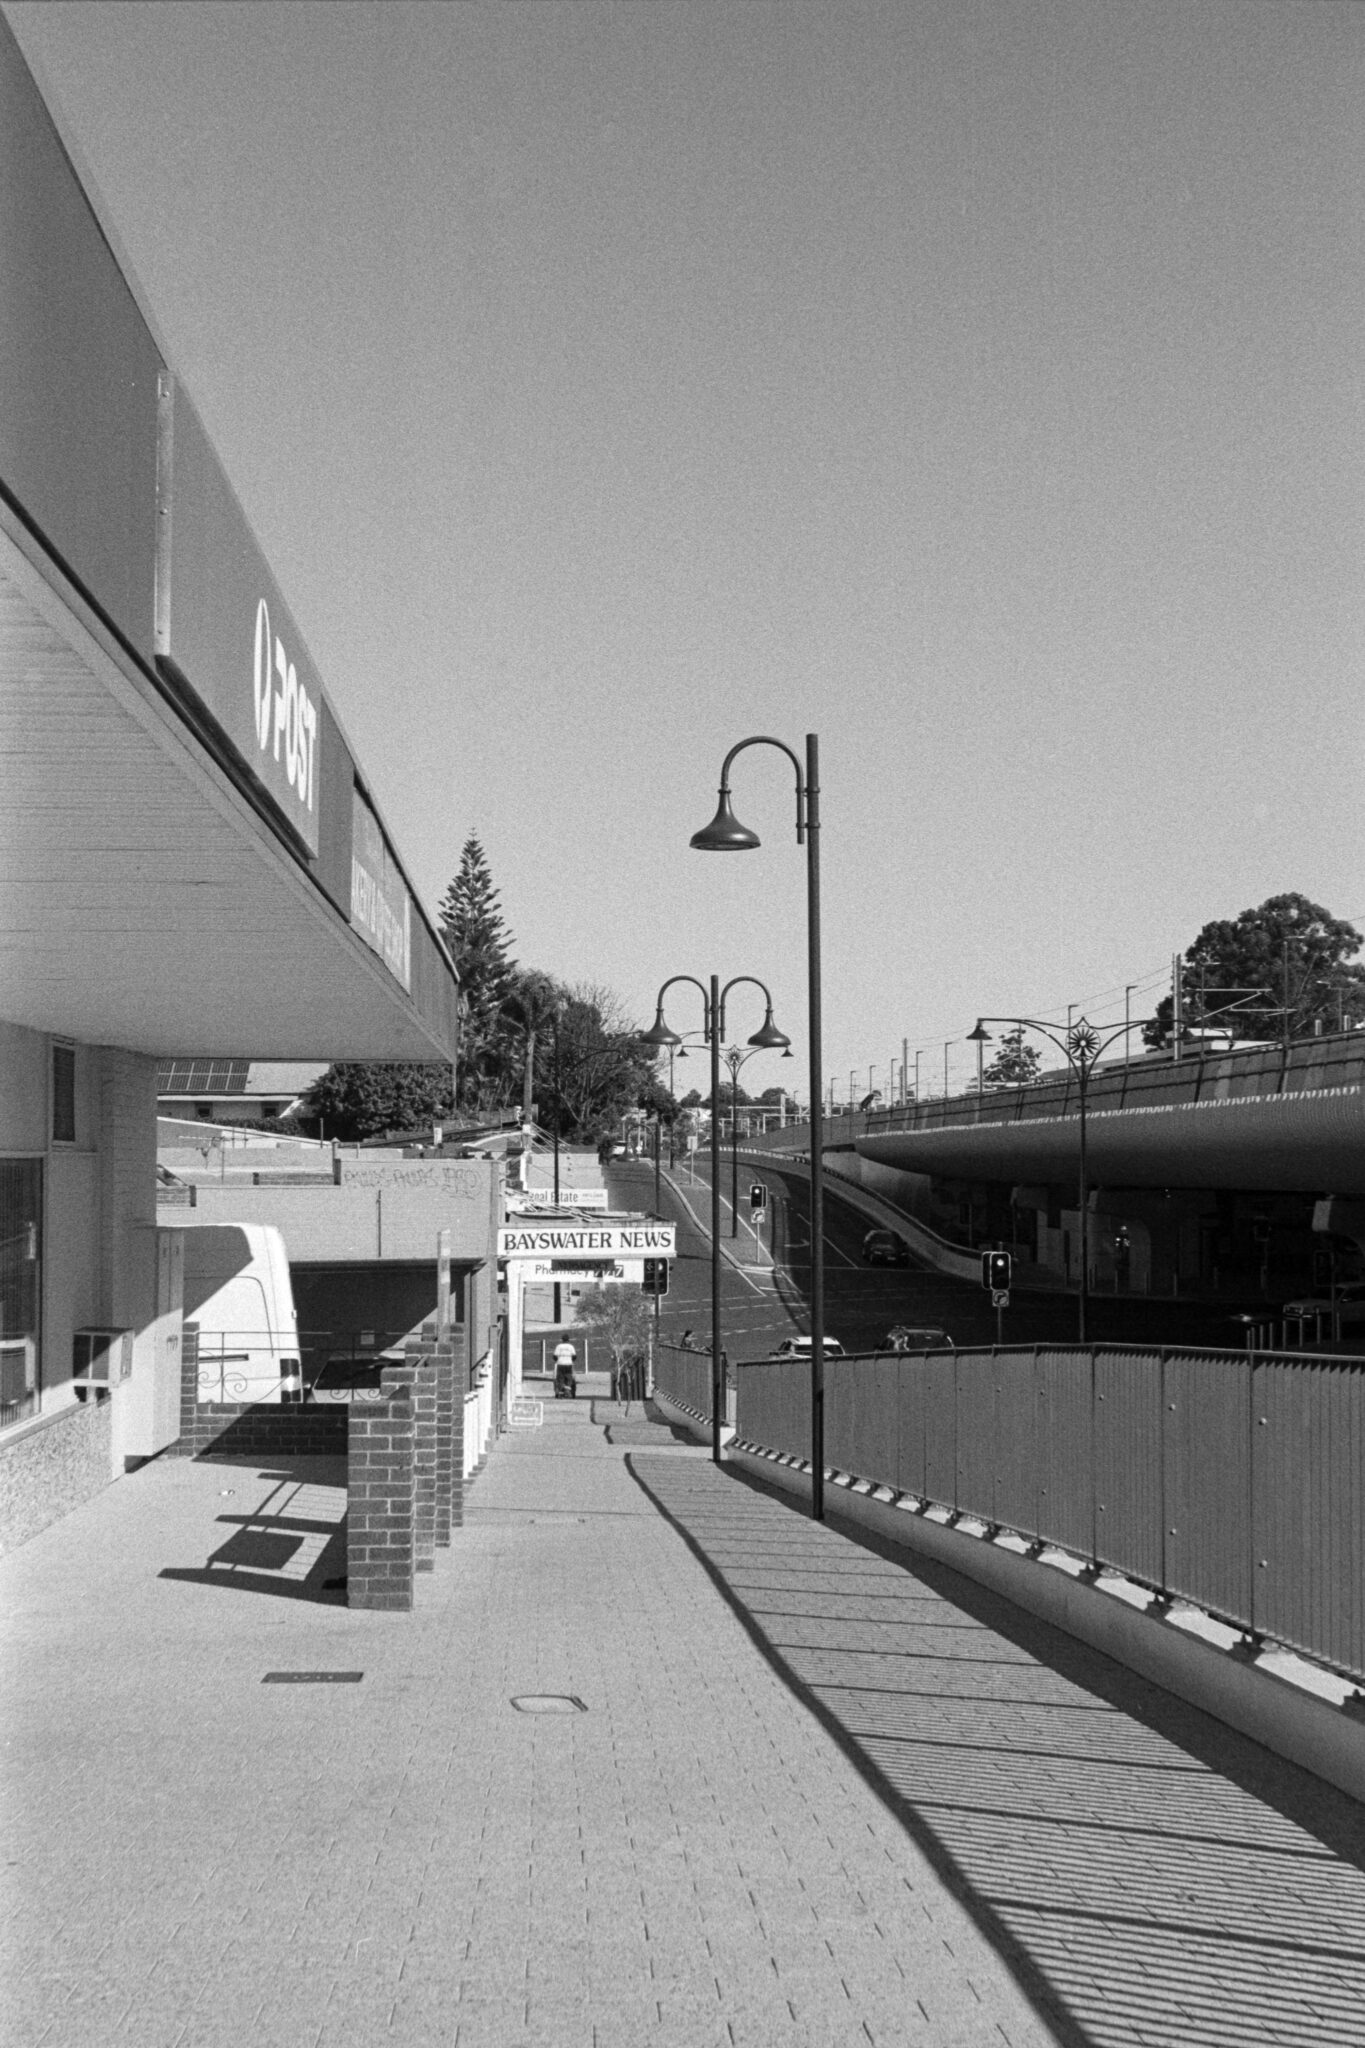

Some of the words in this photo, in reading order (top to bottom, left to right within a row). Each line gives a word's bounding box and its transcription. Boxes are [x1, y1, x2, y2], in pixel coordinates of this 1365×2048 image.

[274, 635, 317, 812] POST
[550, 1191, 579, 1203] Etate
[504, 1231, 612, 1250] BAYSWATER
[620, 1231, 672, 1248] NEWS
